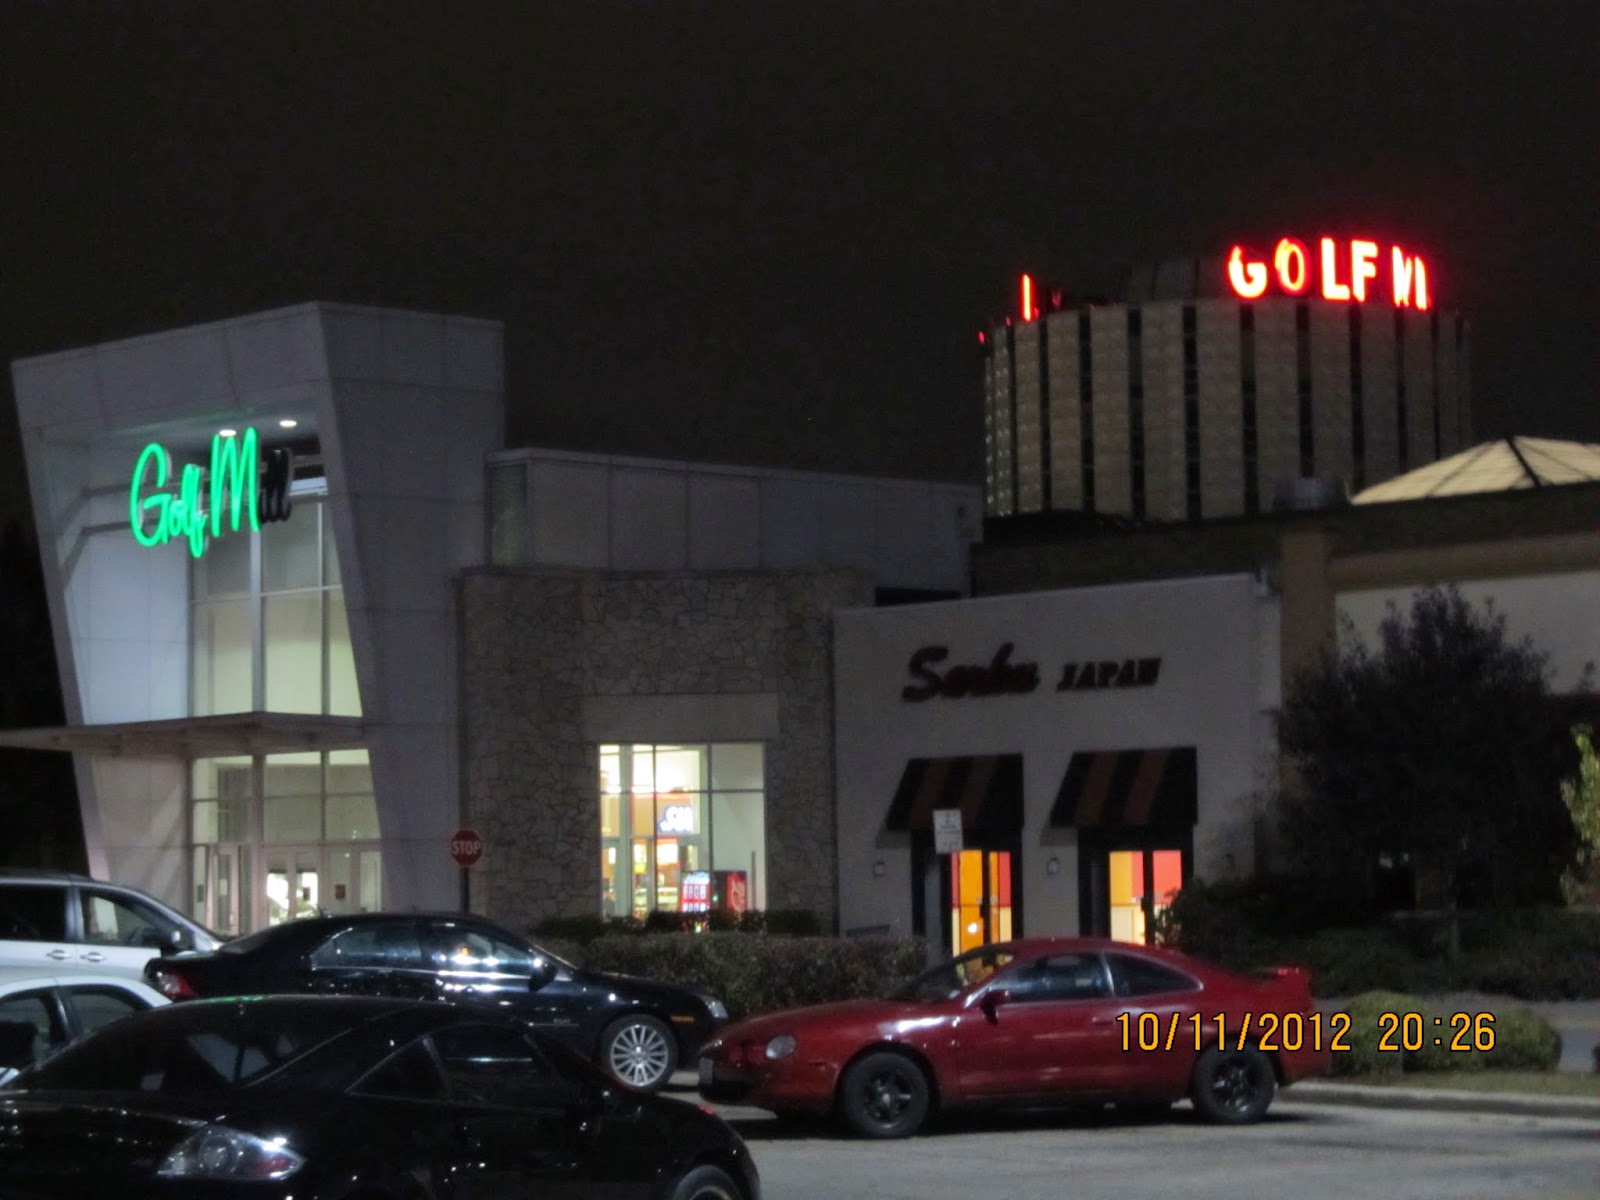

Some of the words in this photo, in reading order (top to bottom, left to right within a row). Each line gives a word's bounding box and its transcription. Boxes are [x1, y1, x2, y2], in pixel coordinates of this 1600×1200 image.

[1228, 236, 1379, 303] GOLF
[129, 442, 208, 558] Golf
[1055, 656, 1162, 692] JAPAN
[452, 840, 481, 855] STOP
